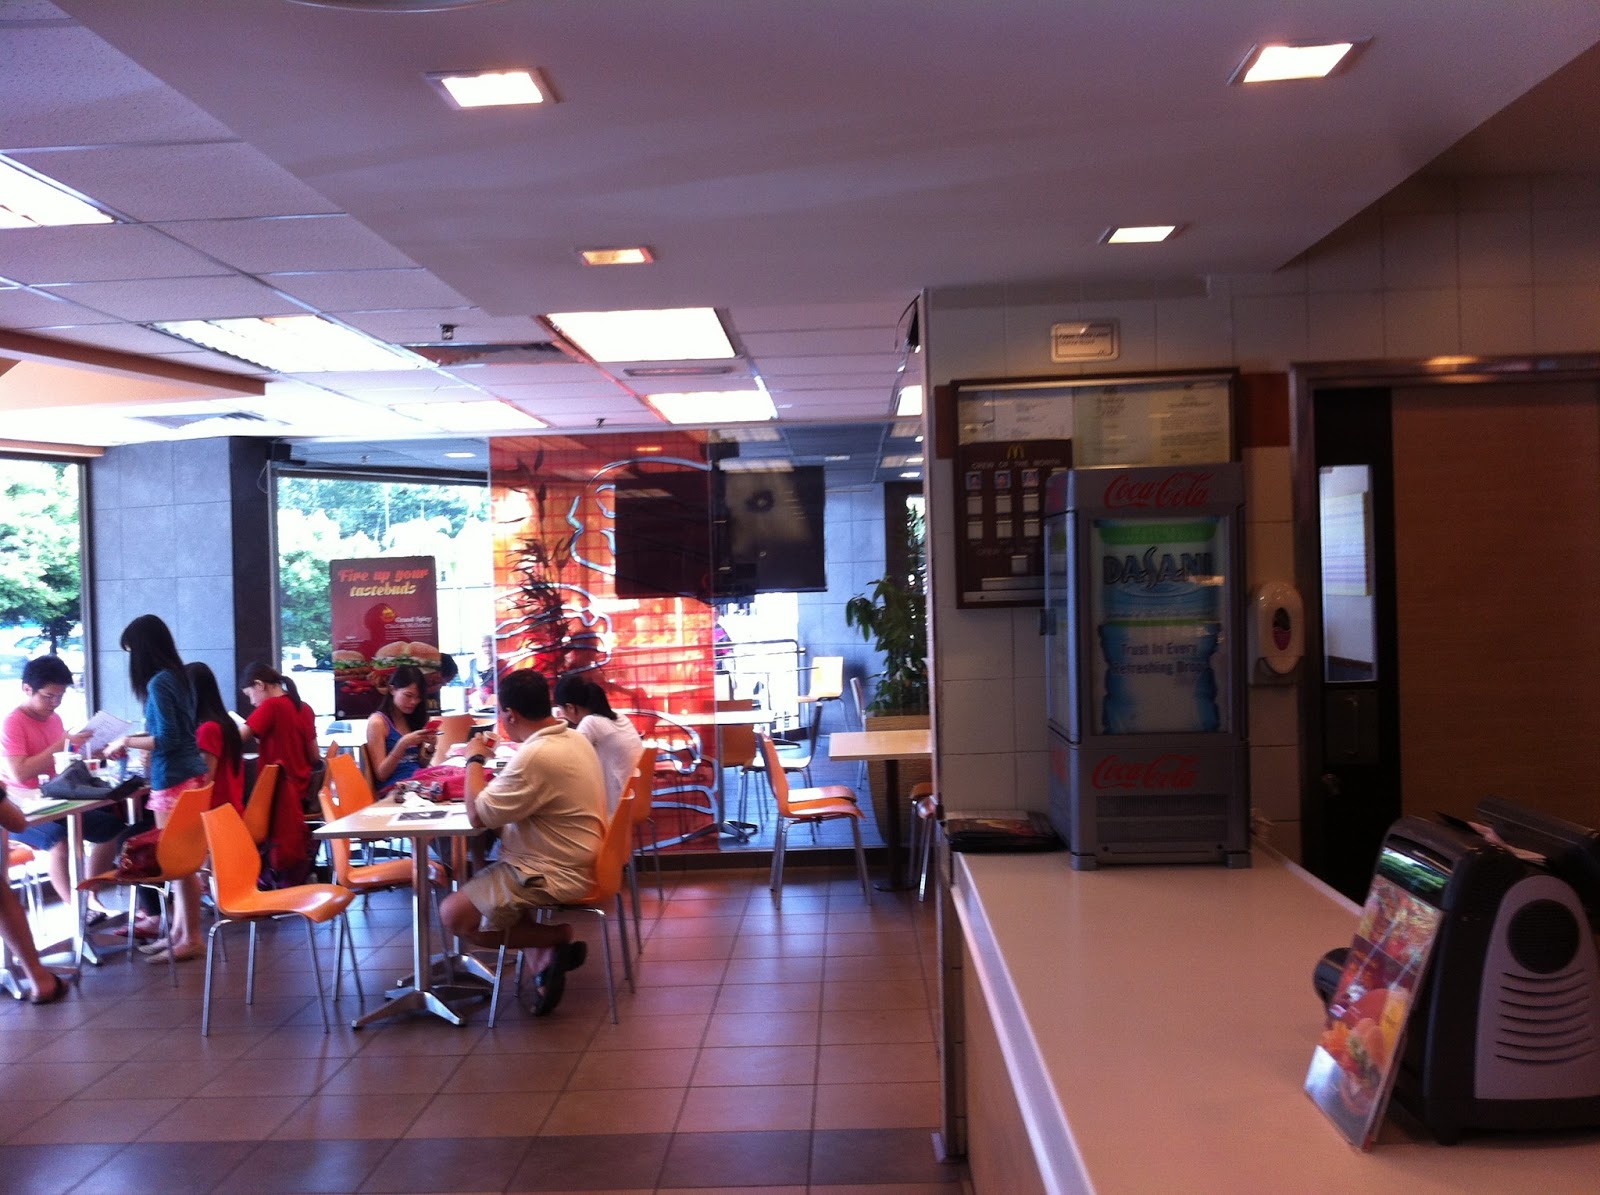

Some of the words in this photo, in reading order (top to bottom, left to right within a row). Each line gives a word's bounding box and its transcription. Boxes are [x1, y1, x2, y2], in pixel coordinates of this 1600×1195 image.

[338, 568, 369, 582] Fire
[373, 570, 391, 583] up
[394, 568, 430, 582] your
[349, 581, 417, 597] tastebuds
[1120, 643, 1149, 655] Trust
[1167, 642, 1198, 657] Every
